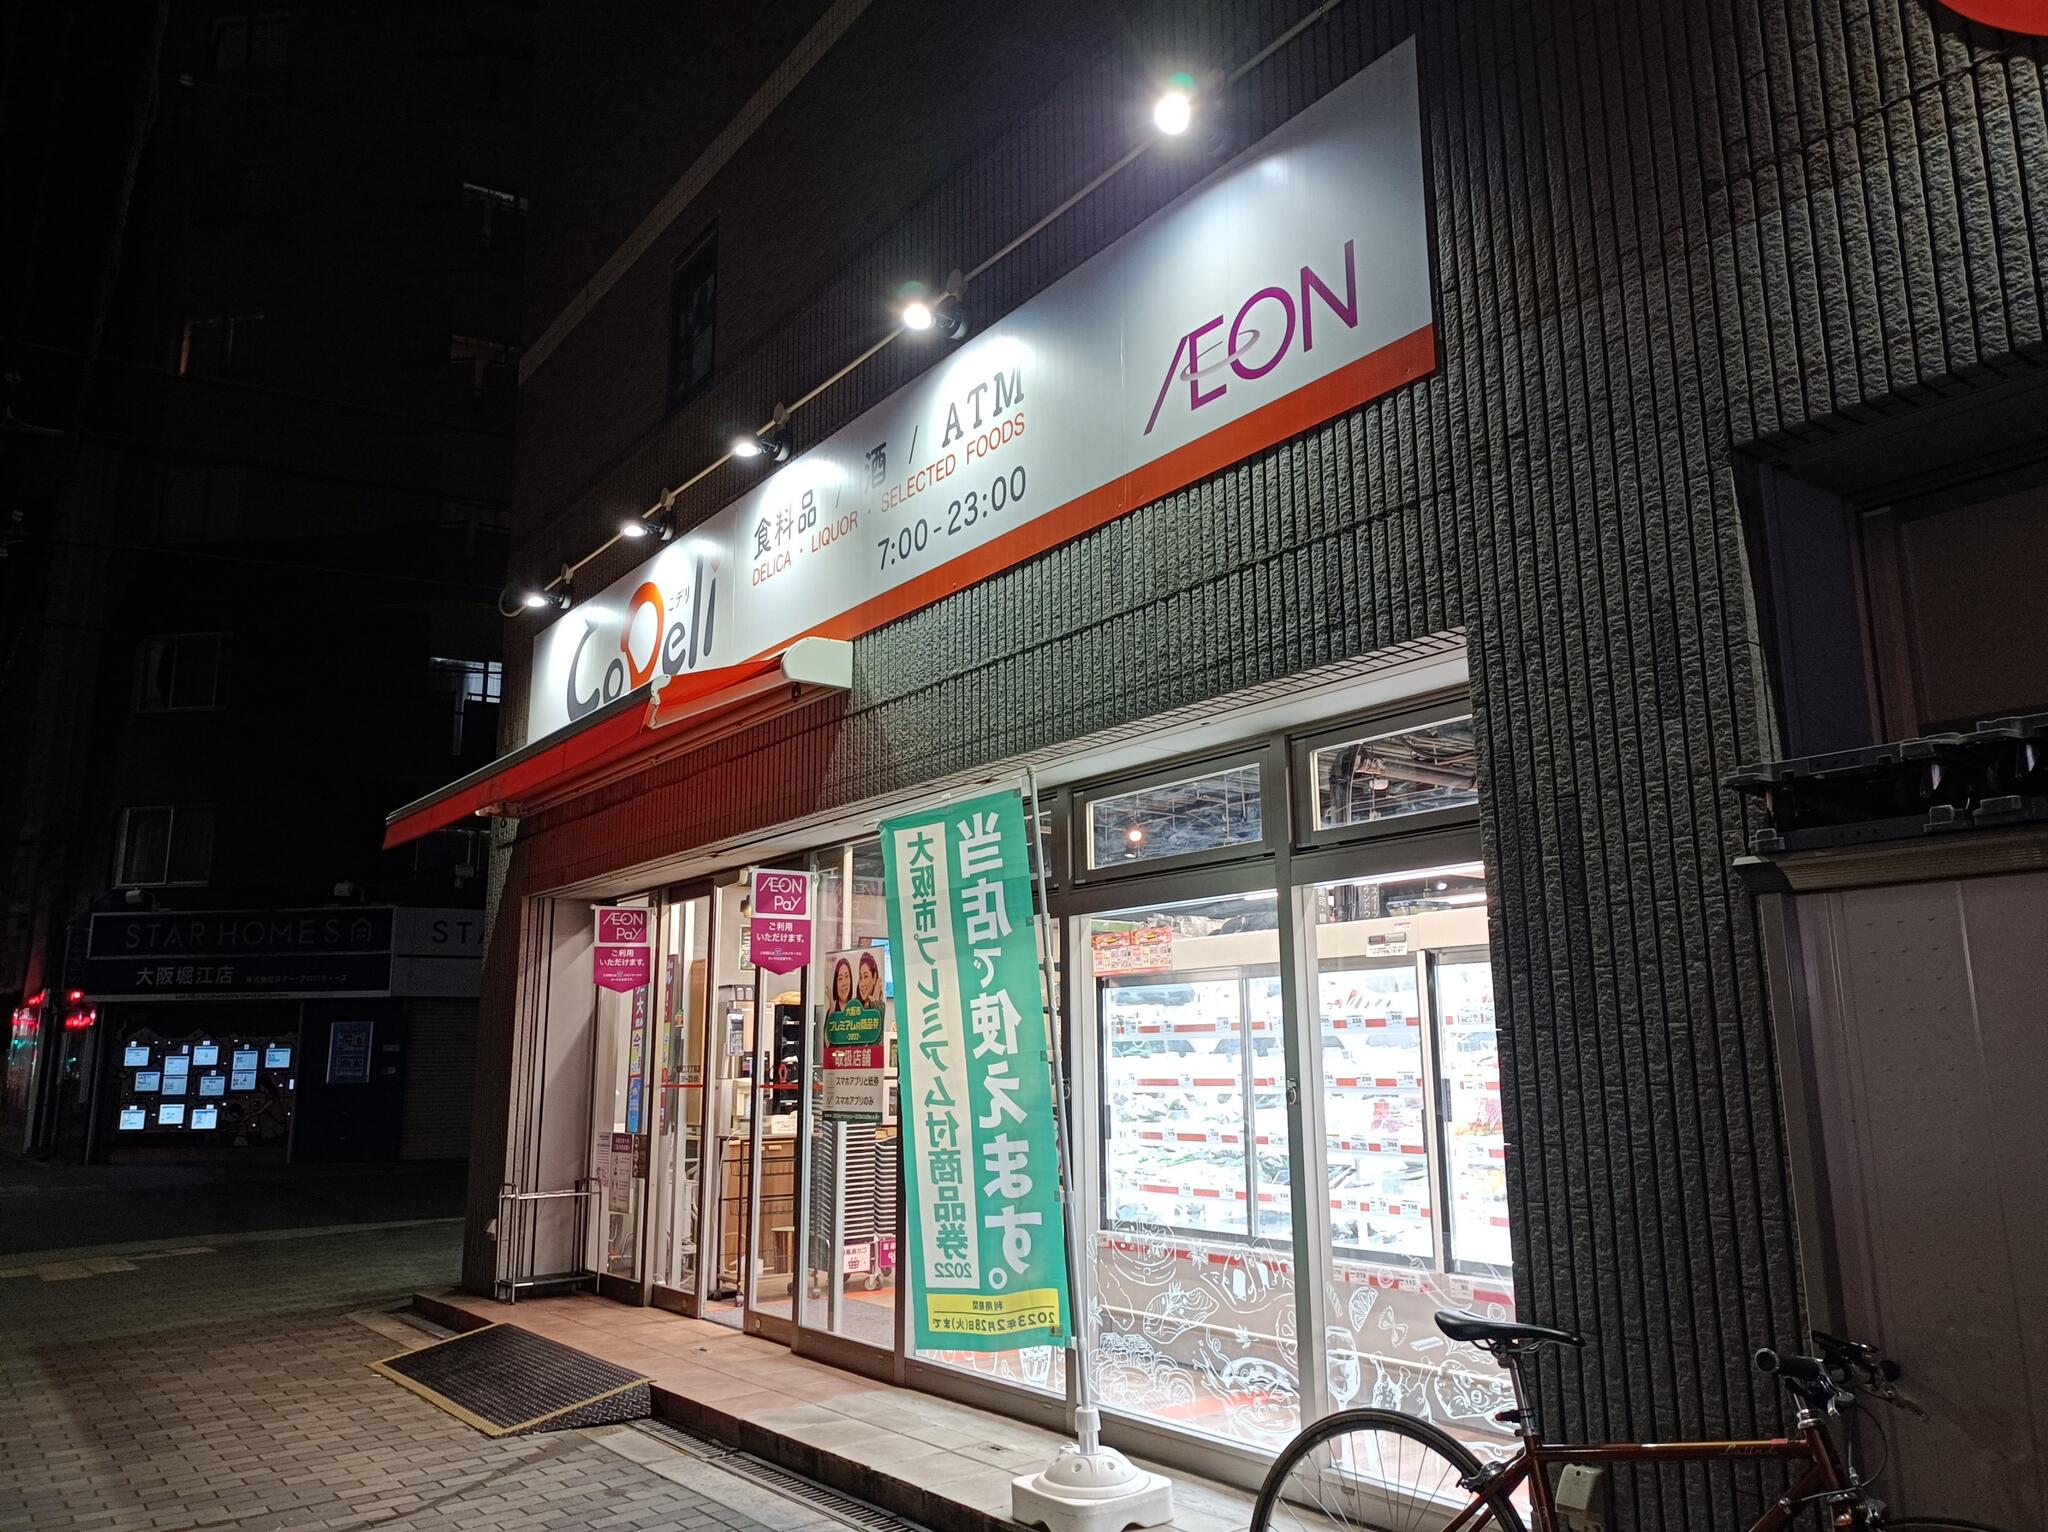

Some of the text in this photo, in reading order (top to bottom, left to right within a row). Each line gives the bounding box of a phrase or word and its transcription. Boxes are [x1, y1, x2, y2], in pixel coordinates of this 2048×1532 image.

[753, 488, 817, 560] 食料品
[864, 441, 887, 494] 酒
[942, 364, 1025, 448] ATM
[752, 411, 1025, 586] DELICA LIQUOR SELECTED FOODS
[124, 918, 342, 950] STAR HOMES
[769, 921, 793, 932] ご利用
[756, 932, 805, 943] いただけます。
[611, 949, 634, 957] ご利用
[599, 958, 645, 966] いただけます。
[135, 965, 235, 986] 大阪堀江店
